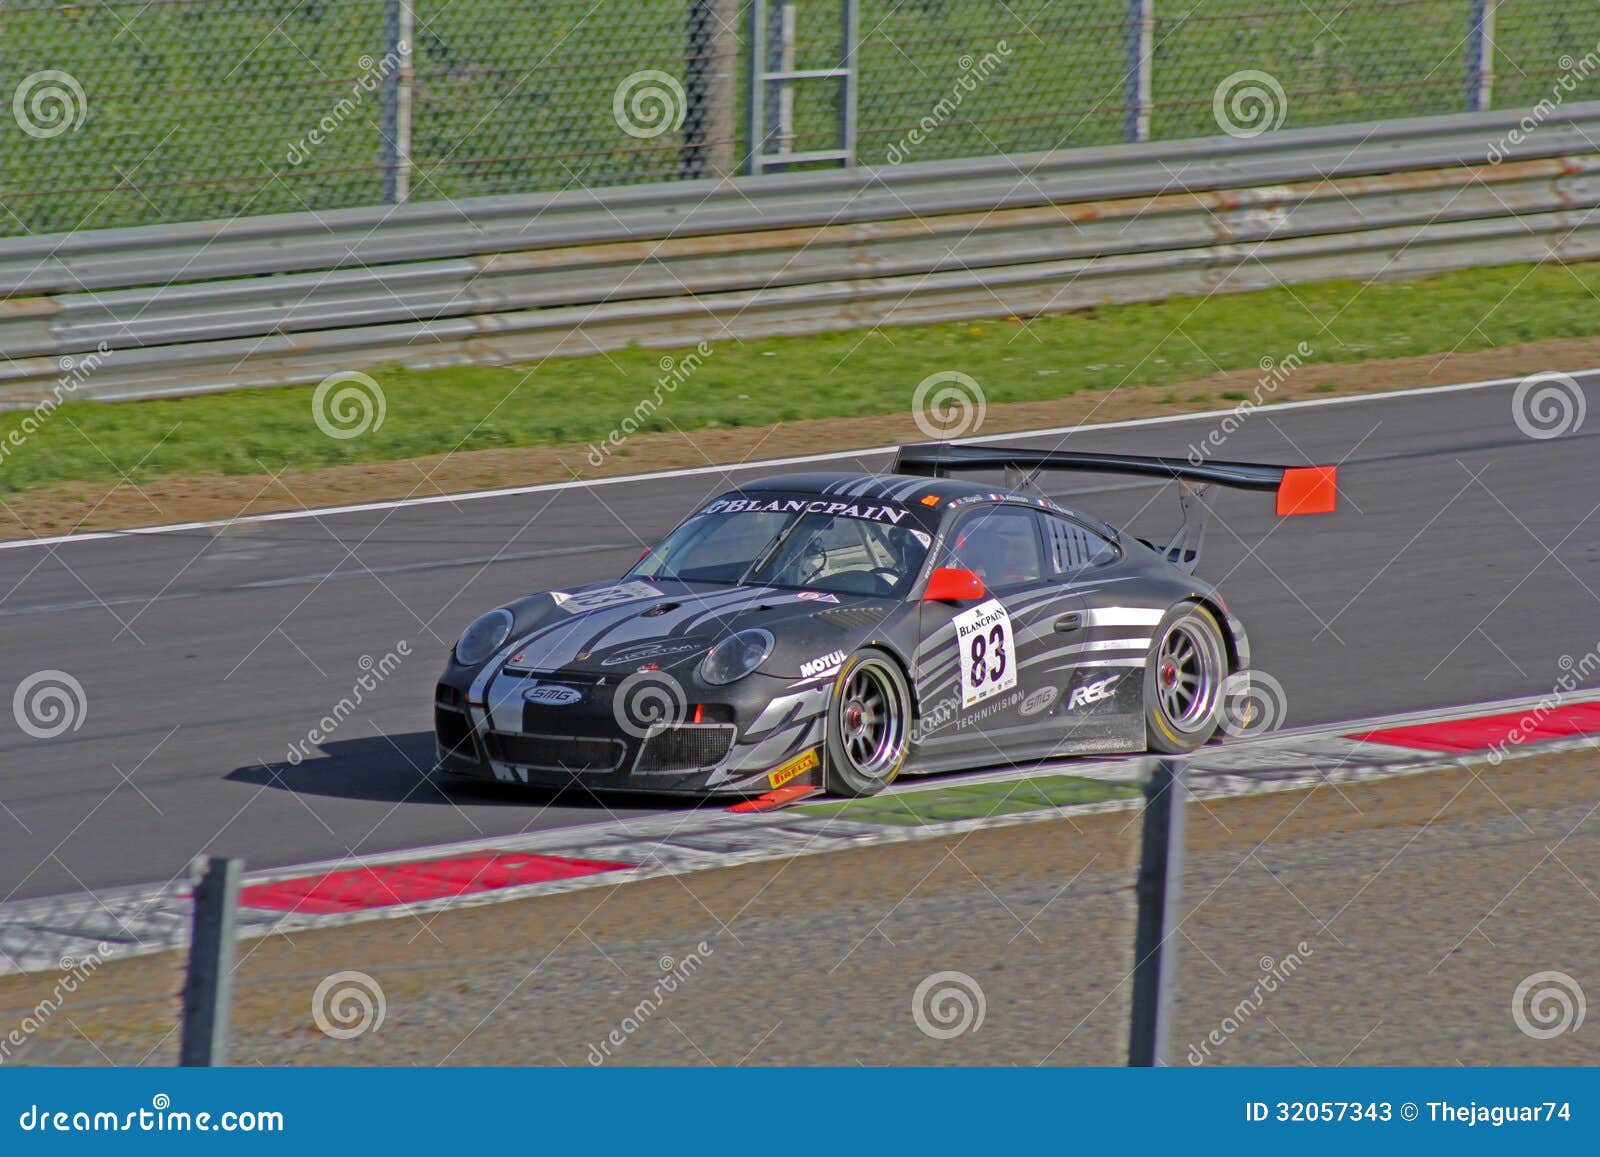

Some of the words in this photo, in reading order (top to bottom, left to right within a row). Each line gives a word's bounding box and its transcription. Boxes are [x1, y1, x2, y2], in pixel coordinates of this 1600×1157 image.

[727, 499, 909, 524] BLANCPAIN
[959, 608, 1005, 637] BLANCPAIN
[800, 649, 848, 678] MOTUL
[970, 623, 1007, 688] 83
[532, 689, 571, 701] SMG
[956, 689, 1025, 731] TECHNIVISION
[773, 754, 815, 784] PIRELLI
